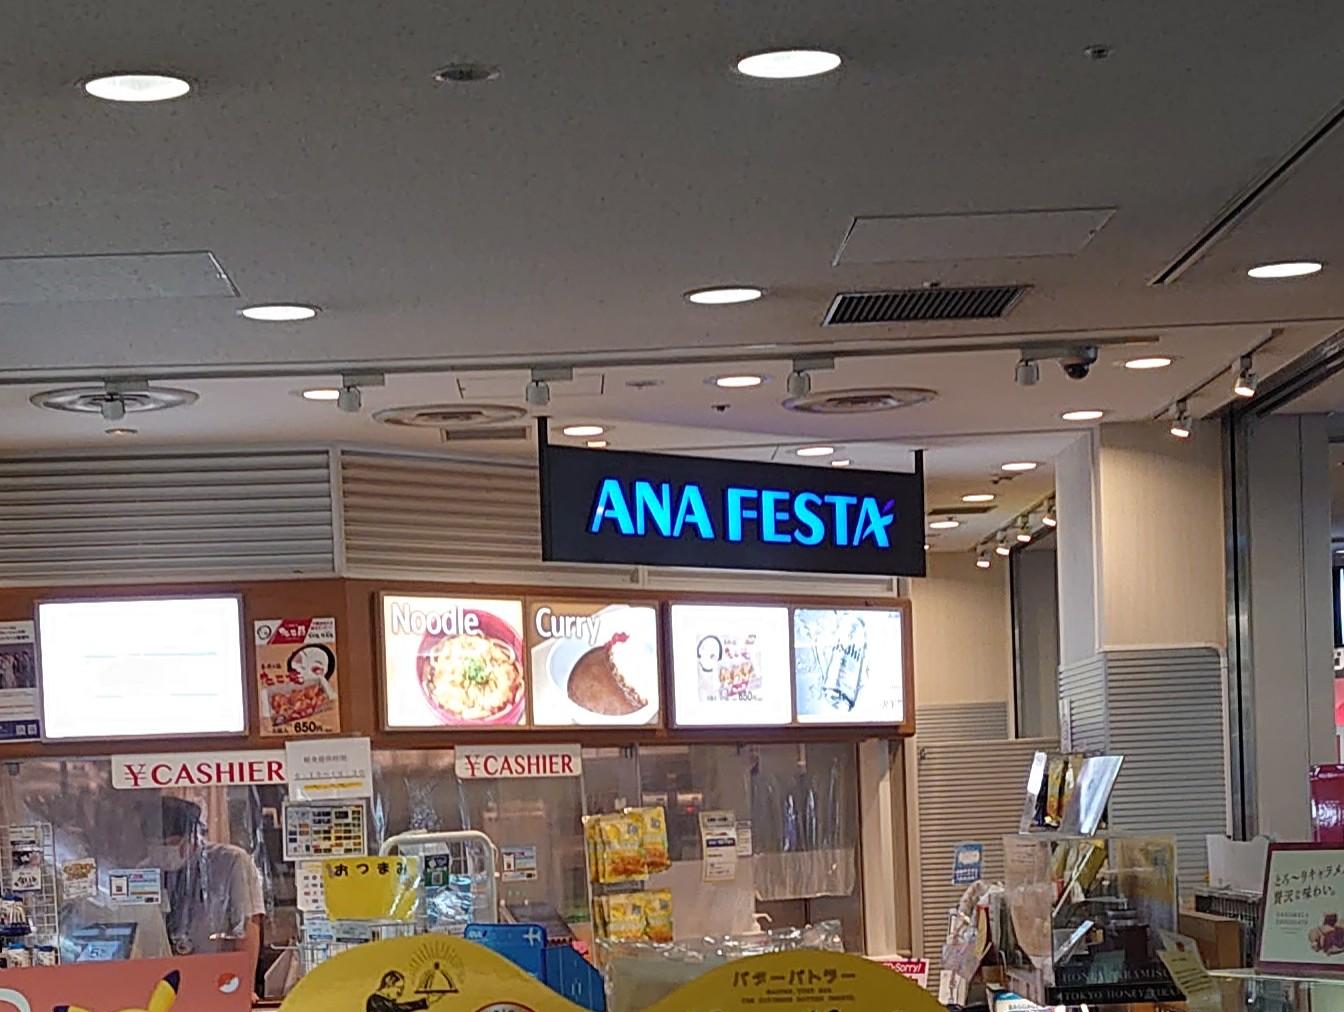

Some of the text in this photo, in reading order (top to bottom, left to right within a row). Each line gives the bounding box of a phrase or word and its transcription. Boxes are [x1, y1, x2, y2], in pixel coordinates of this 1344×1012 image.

[591, 479, 894, 549] ANA FESTA
[391, 603, 480, 637] Noodle
[535, 607, 601, 644] Curry
[151, 760, 285, 785] CASHIER
[484, 754, 574, 777] CASHIER
